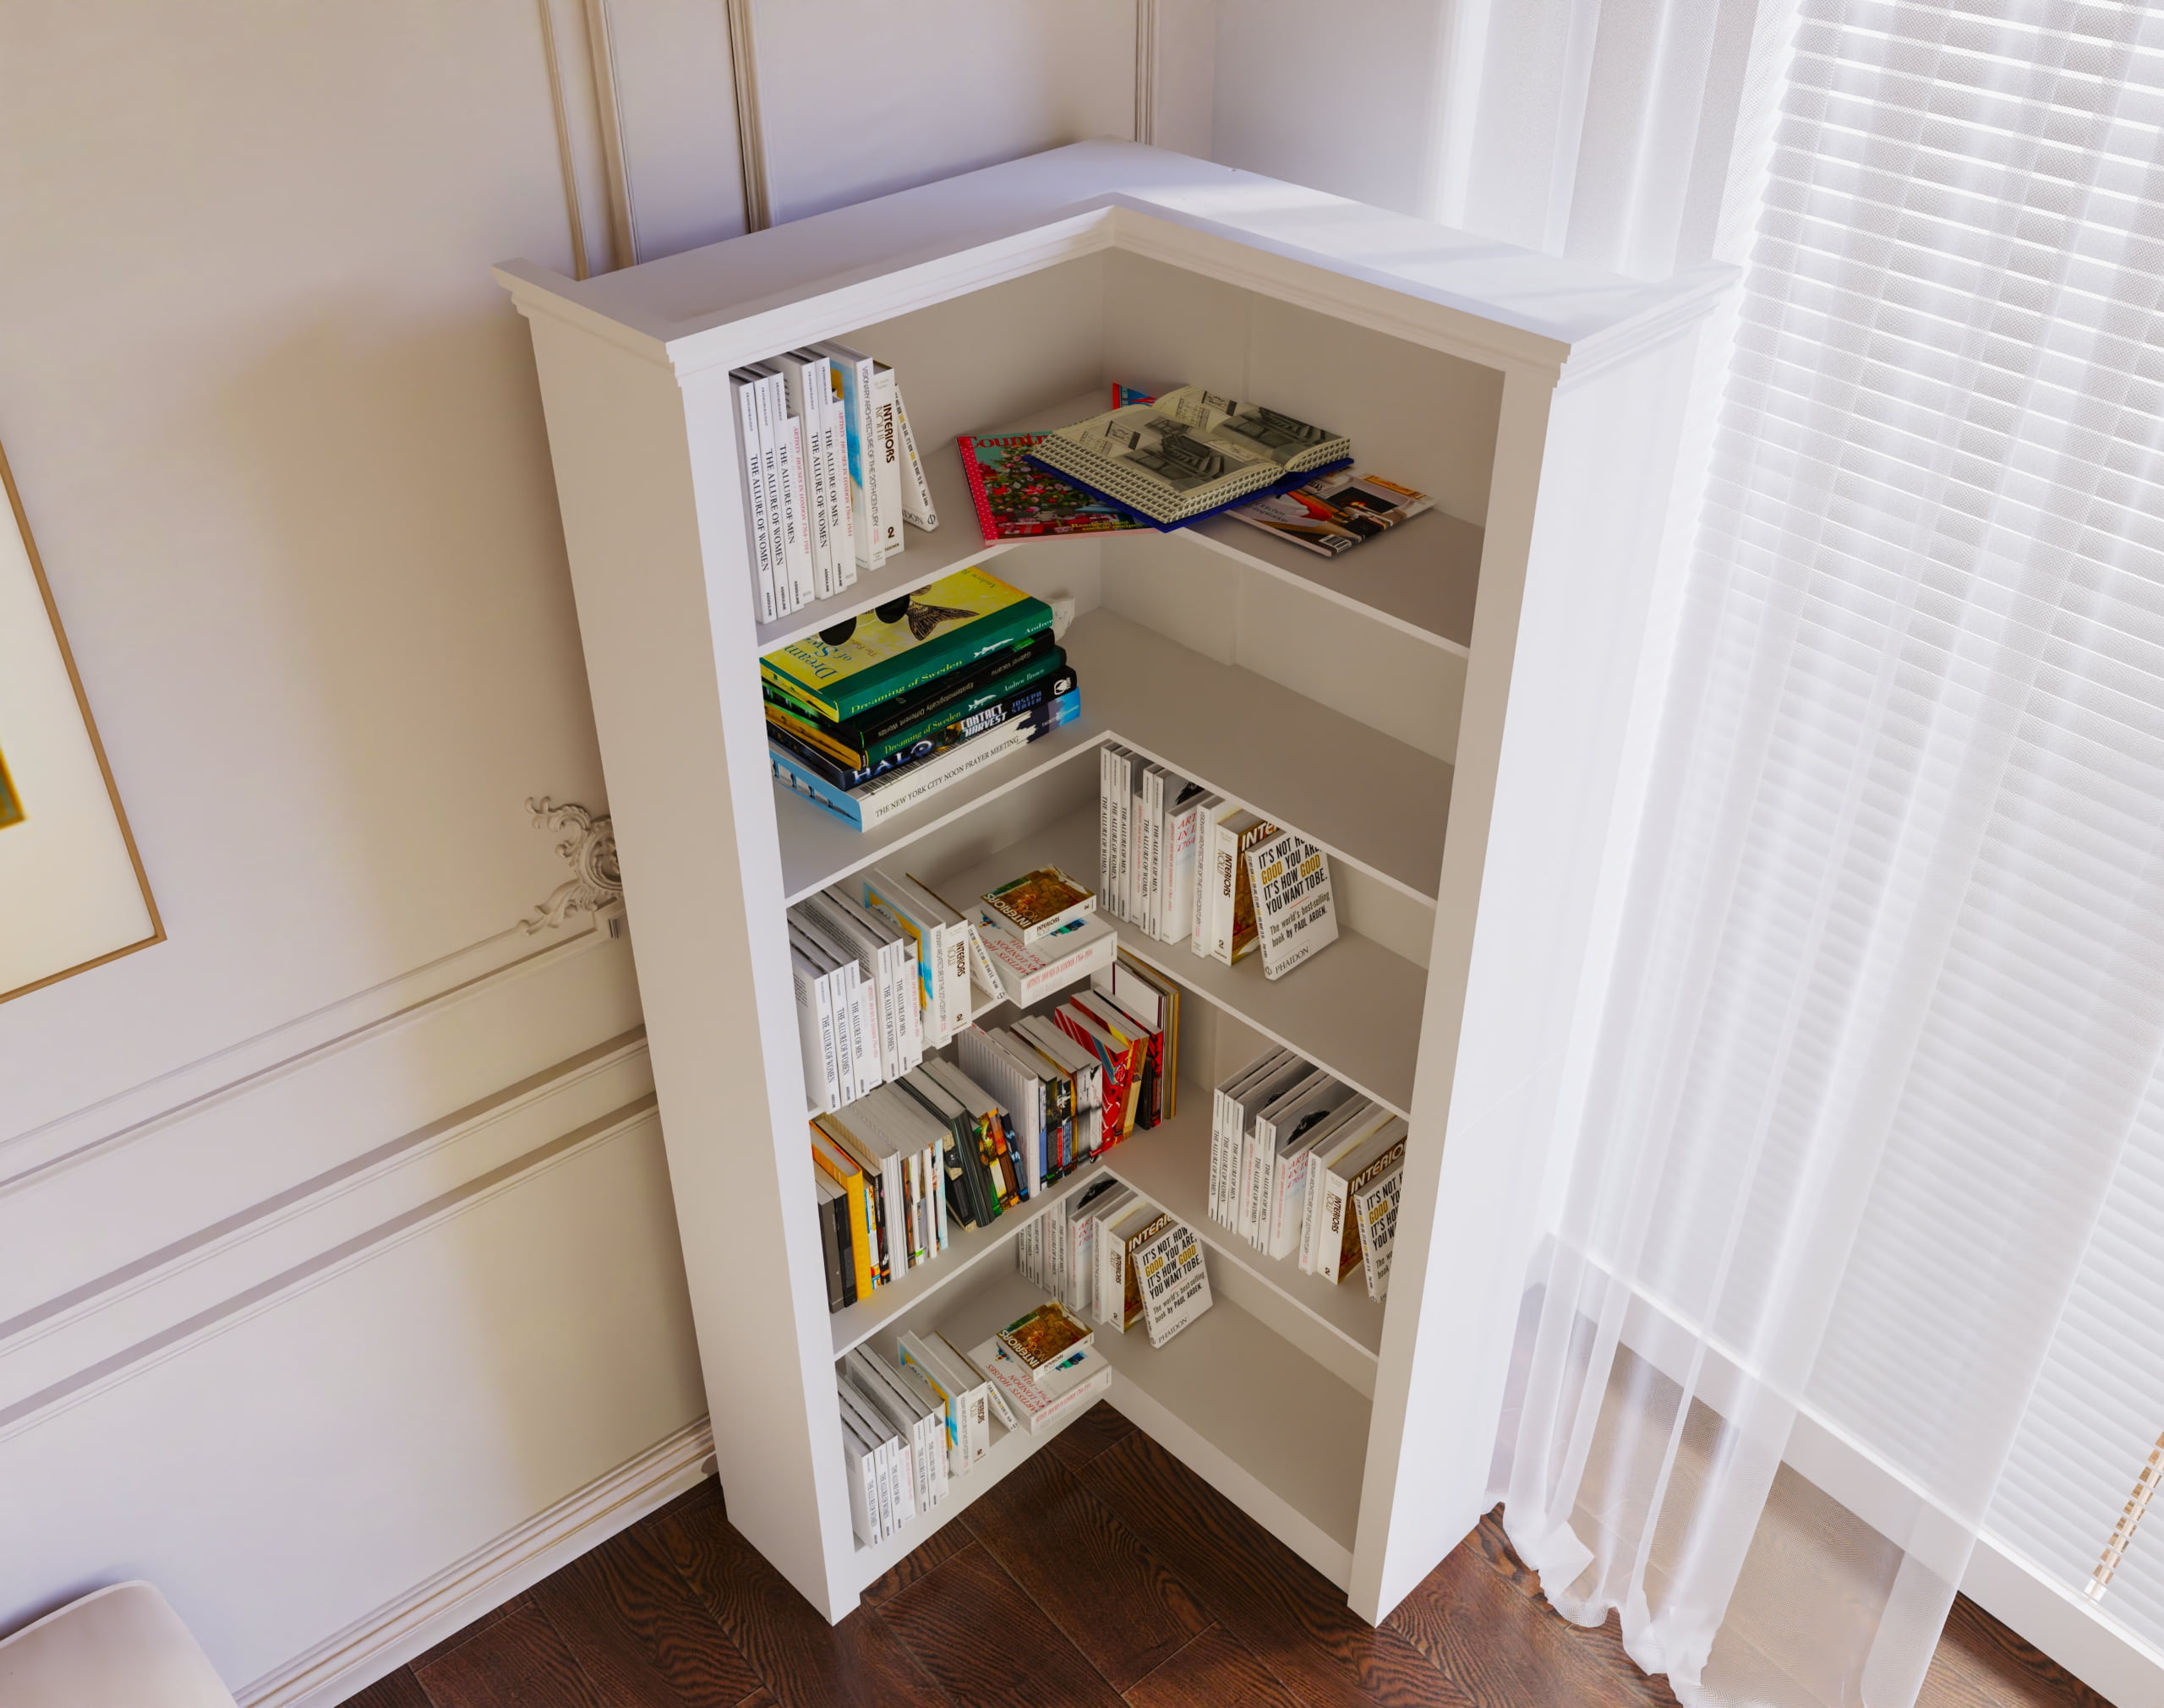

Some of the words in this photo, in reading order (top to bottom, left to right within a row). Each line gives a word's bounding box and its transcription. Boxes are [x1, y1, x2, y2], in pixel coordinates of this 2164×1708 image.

[825, 428, 833, 449] THE
[865, 401, 873, 449] ARCHITECTURE
[883, 403, 894, 463] INTERIORS
[959, 433, 1048, 449] Countr
[766, 448, 774, 472] THE
[779, 443, 788, 467] THE
[812, 431, 820, 455] THE
[751, 453, 761, 477] THE
[813, 456, 823, 494] ALLURE
[827, 450, 837, 488] ALLURE
[752, 478, 764, 517] ALLURE
[768, 473, 779, 512] ALLURE
[782, 468, 792, 505] ALLURE
[817, 495, 825, 509] OF
[830, 490, 838, 504] OF
[757, 517, 765, 531] OF
[771, 512, 780, 526] OF
[786, 507, 795, 520] OF
[818, 510, 828, 548] WOMEN
[773, 527, 784, 566] WOMEN
[888, 527, 894, 538] 2
[758, 532, 770, 572] WOMEN
[784, 644, 839, 679] Dream
[833, 652, 852, 662] of
[852, 686, 904, 713] Dreaming
[908, 678, 920, 688] of
[921, 660, 964, 682] Sweden
[926, 683, 974, 711] Epistemologically
[877, 723, 899, 737] Worlds
[884, 732, 921, 754] Dreaming
[923, 725, 932, 735] of
[932, 712, 961, 728] Sweden
[1003, 679, 1025, 692] Andrew
[899, 708, 925, 726] Different
[960, 703, 1003, 730] CONTACT
[962, 712, 1008, 738] HARVEST
[852, 740, 932, 784] HALO
[876, 805, 889, 818] THE
[890, 796, 907, 811] NEW
[908, 786, 926, 800] YORK
[927, 776, 943, 790] CITY
[943, 765, 965, 782] NOON
[965, 752, 990, 769] PRAYER
[990, 736, 1019, 757] MEETING
[1143, 860, 1148, 871] OF
[1153, 866, 1158, 876] OF
[1259, 849, 1275, 870] IT'S
[1276, 838, 1292, 859] NOT
[1261, 860, 1283, 886] GOOD
[1285, 849, 1302, 870] YOU
[1224, 854, 1232, 898] INTERIORS
[1264, 880, 1280, 901] IT'S
[1281, 867, 1298, 891] HOW
[1299, 854, 1320, 878] GOOD
[984, 892, 1032, 928] INTERIORS
[1266, 894, 1281, 916] YOU
[1282, 881, 1303, 906] WANT
[1270, 923, 1280, 936] The
[1281, 910, 1300, 928] world's
[1301, 892, 1331, 916] best-selling
[1036, 916, 1060, 931] INTERIORS
[1271, 933, 1286, 947] book
[1286, 930, 1293, 938] by
[1293, 918, 1308, 933] PAUL
[1309, 905, 1327, 923] ARDEN.
[956, 940, 965, 977] INTERIORS
[994, 940, 1028, 964] LONDON
[1275, 947, 1310, 974] PHAIDON
[899, 1015, 906, 1024] OF
[1351, 1143, 1406, 1195] INTERIO
[1366, 1190, 1381, 1212] IT'S
[1382, 1176, 1396, 1198] NOT
[1369, 1198, 1389, 1225] GOOD
[1390, 1188, 1401, 1207] YO
[1332, 1195, 1342, 1234] INTERIORS
[1371, 1218, 1385, 1238] IT'S
[1143, 1248, 1156, 1266] IT'S
[1156, 1237, 1171, 1256] NOT
[1173, 1227, 1189, 1244] HOW
[1145, 1256, 1163, 1278] GOOD
[1165, 1246, 1180, 1261] YOU
[1182, 1232, 1197, 1251] ARE,
[1373, 1231, 1388, 1251] YOU
[1147, 1271, 1161, 1290] IT'S
[1162, 1261, 1178, 1279] HOW
[1178, 1244, 1197, 1265] GOOD
[1376, 1257, 1385, 1269] The
[1150, 1281, 1163, 1300] YOU
[1164, 1269, 1183, 1291] WANT
[1153, 1305, 1162, 1315] The
[1163, 1291, 1180, 1307] world's
[1180, 1271, 1205, 1294] best-selling
[1155, 1311, 1167, 1323] book
[1173, 1298, 1185, 1310] PAUL
[1187, 1283, 1203, 1298] ARDEN.
[999, 1329, 1040, 1367] INTERIORS
[1158, 1318, 1189, 1344] PHAIDON
[986, 1364, 1012, 1387] HOUSES
[1008, 1374, 1037, 1401] LONDON
